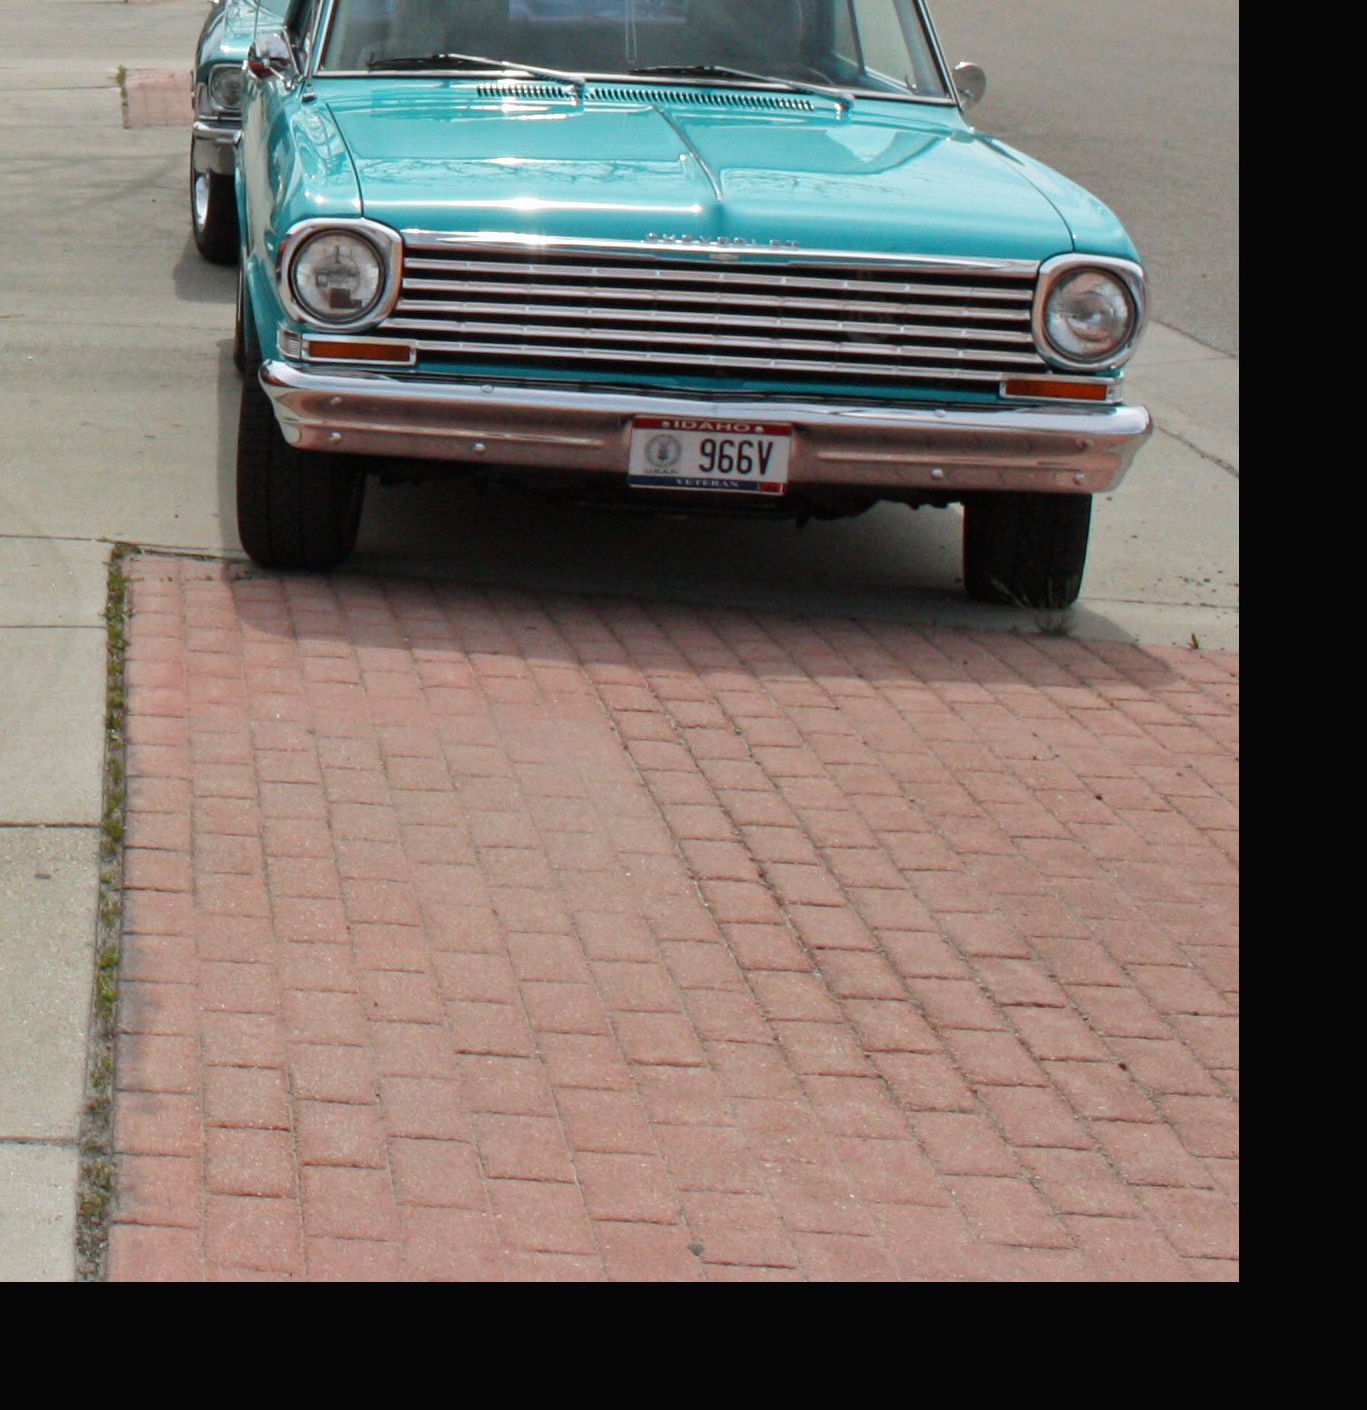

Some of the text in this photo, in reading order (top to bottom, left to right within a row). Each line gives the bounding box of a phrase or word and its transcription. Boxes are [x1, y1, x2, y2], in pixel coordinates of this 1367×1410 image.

[673, 420, 751, 433] IDAHO
[698, 438, 774, 476] 966V
[676, 478, 739, 488] VETERAN
